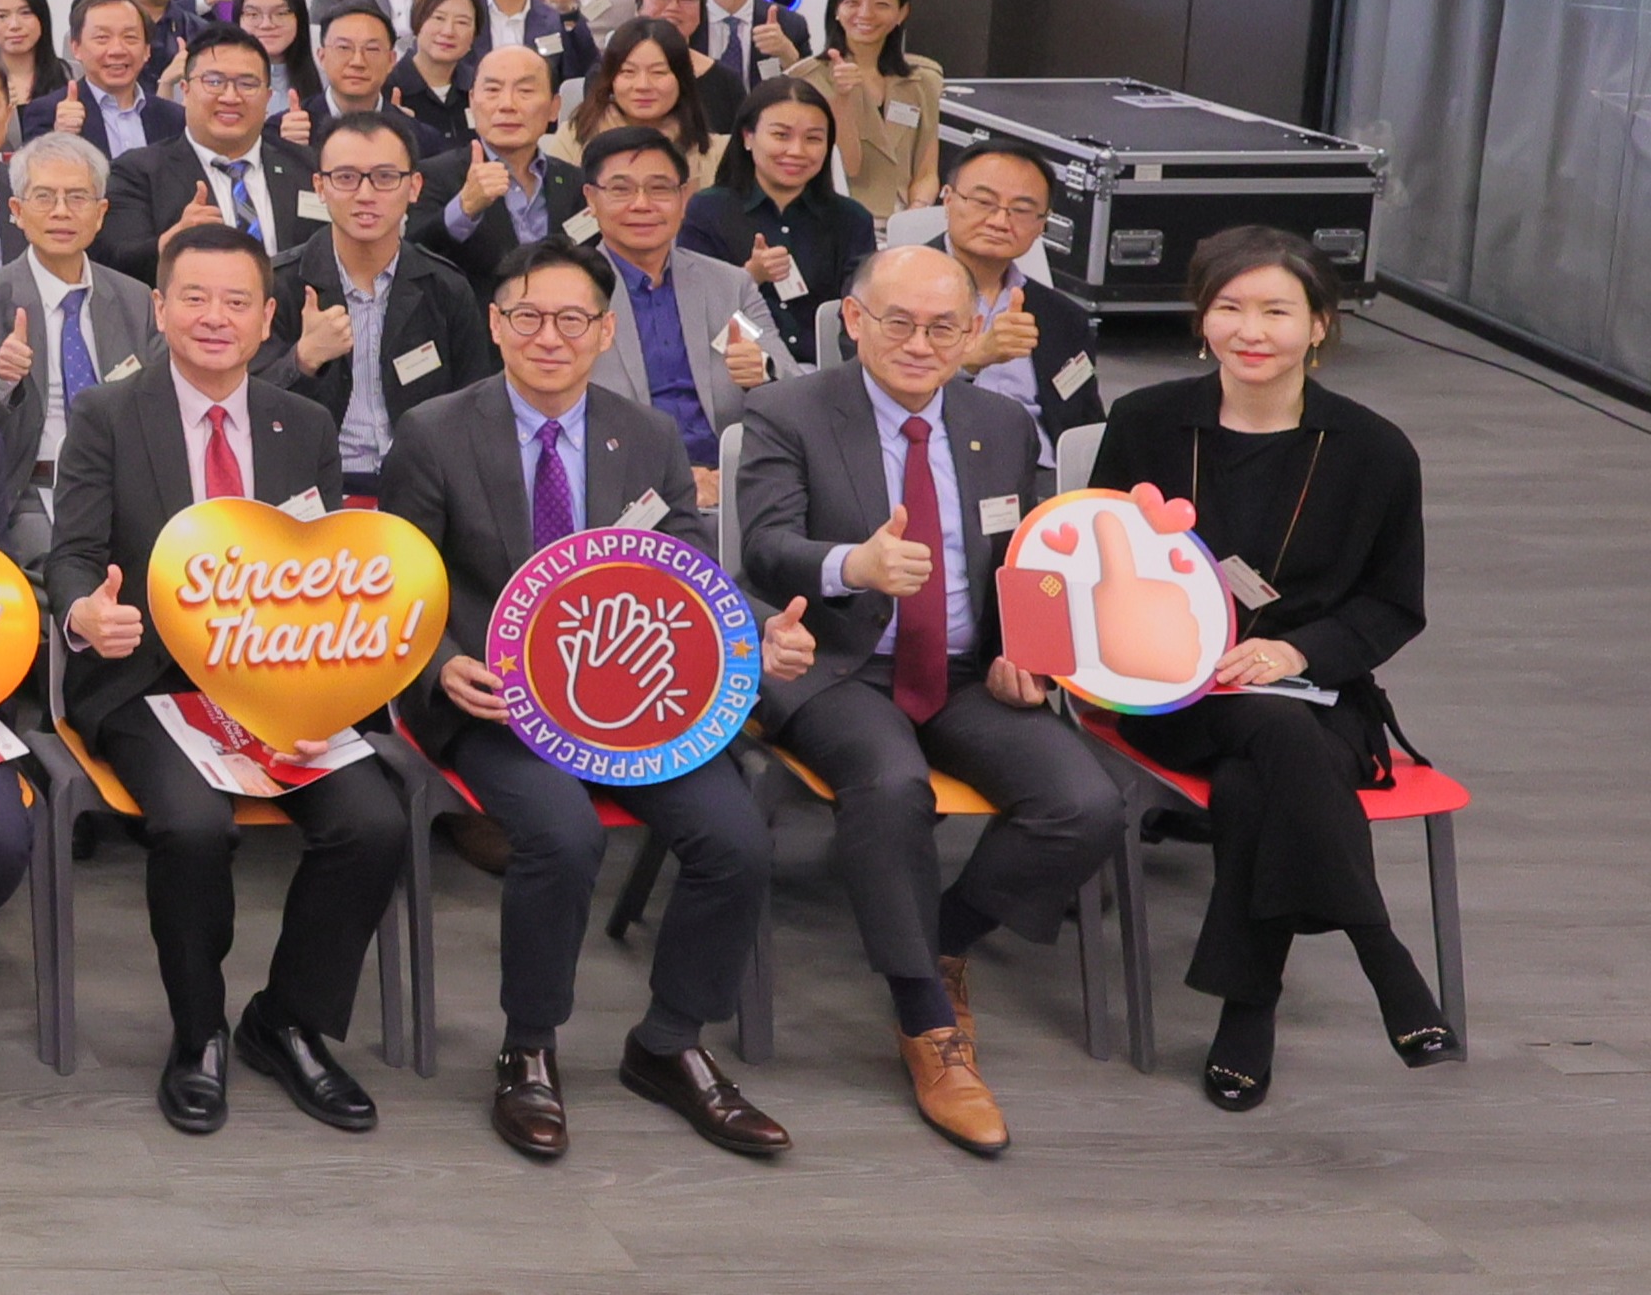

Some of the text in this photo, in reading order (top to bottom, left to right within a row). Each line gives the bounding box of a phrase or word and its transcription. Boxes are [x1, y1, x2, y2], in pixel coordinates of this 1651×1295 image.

[176, 545, 395, 606] Sincere
[498, 534, 747, 642] GREATLY APPRECIATED
[503, 673, 752, 779] GREATLY APPRECIATED
